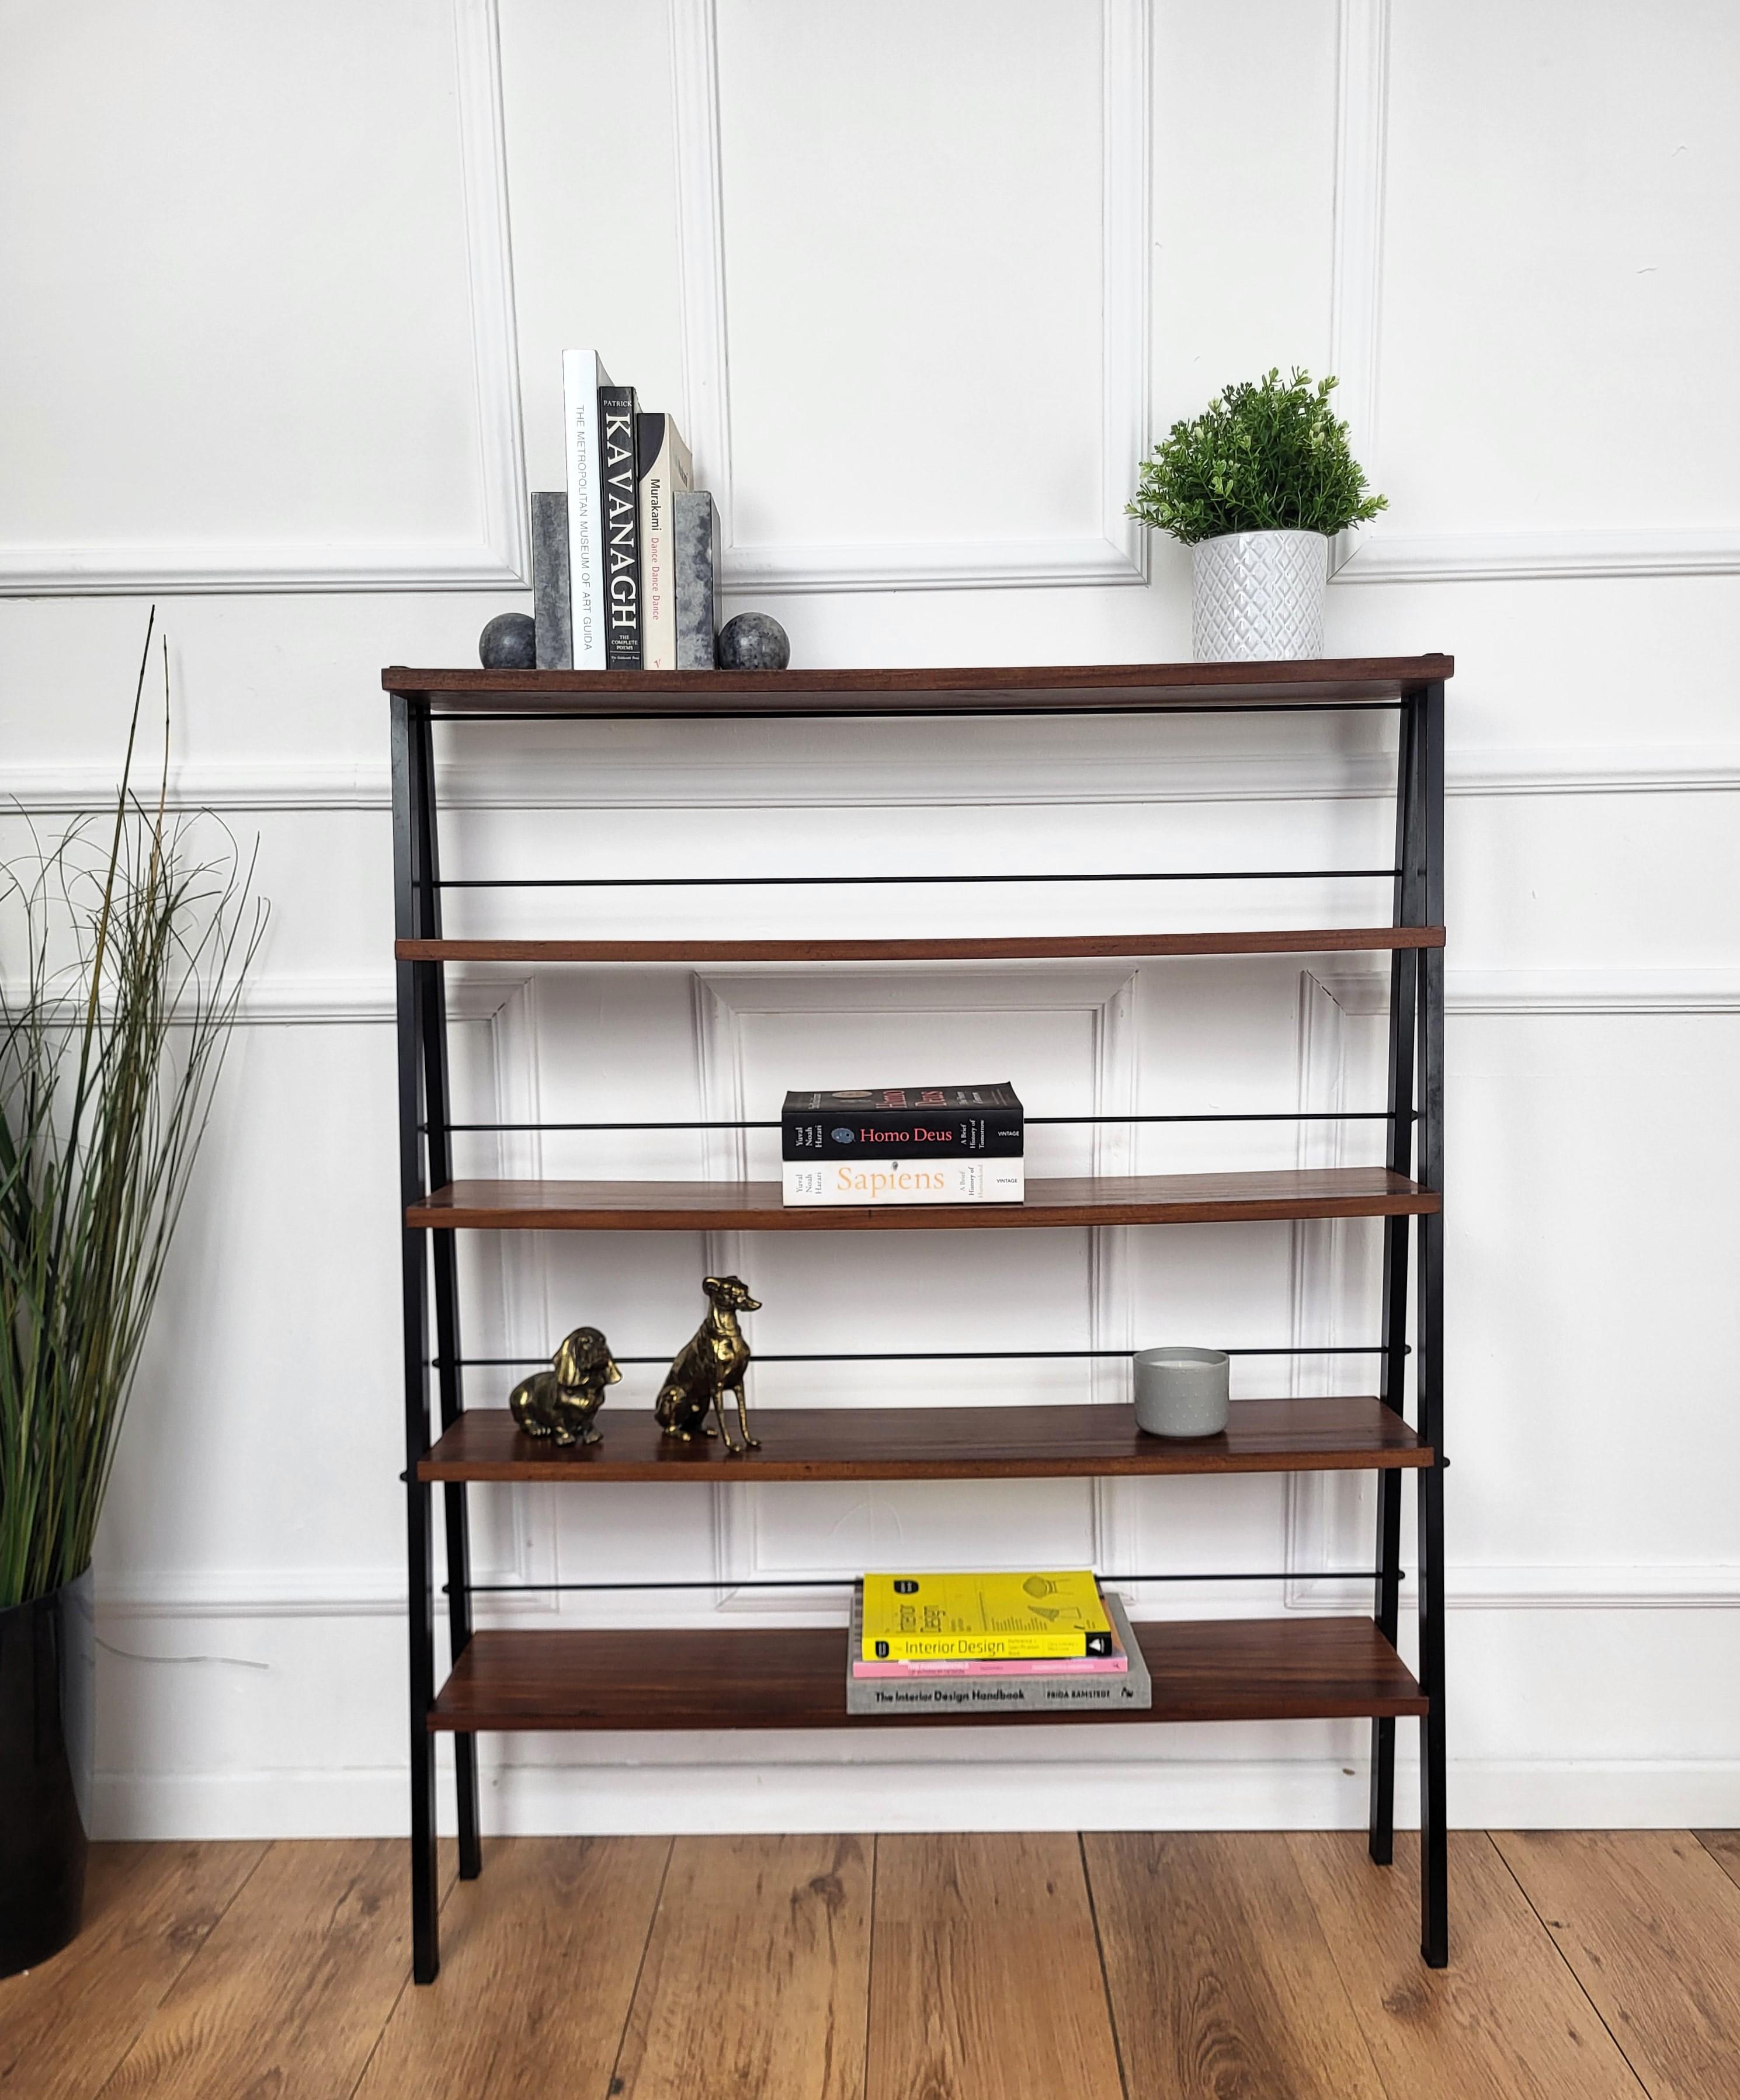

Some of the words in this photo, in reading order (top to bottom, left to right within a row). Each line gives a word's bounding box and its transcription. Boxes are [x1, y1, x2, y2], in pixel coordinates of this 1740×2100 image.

[576, 405, 584, 427] THE
[576, 431, 588, 517] METROPOLITAN
[650, 479, 662, 531] Murakami
[606, 413, 637, 630] KAVANAGH
[579, 521, 589, 569] MUSEUM
[582, 573, 590, 588] OF
[582, 592, 591, 613] ART
[583, 617, 592, 651] GUIDA
[860, 1129, 909, 1142] Homo
[914, 1128, 953, 1141] Deus
[837, 1167, 944, 1198] Sapiens
[906, 1642, 954, 1654] Interior
[958, 1640, 1005, 1656] Design
[876, 1691, 893, 1702] The
[895, 1690, 932, 1702] Interior
[935, 1690, 970, 1702] Design
[973, 1688, 1024, 1701] Handbook
